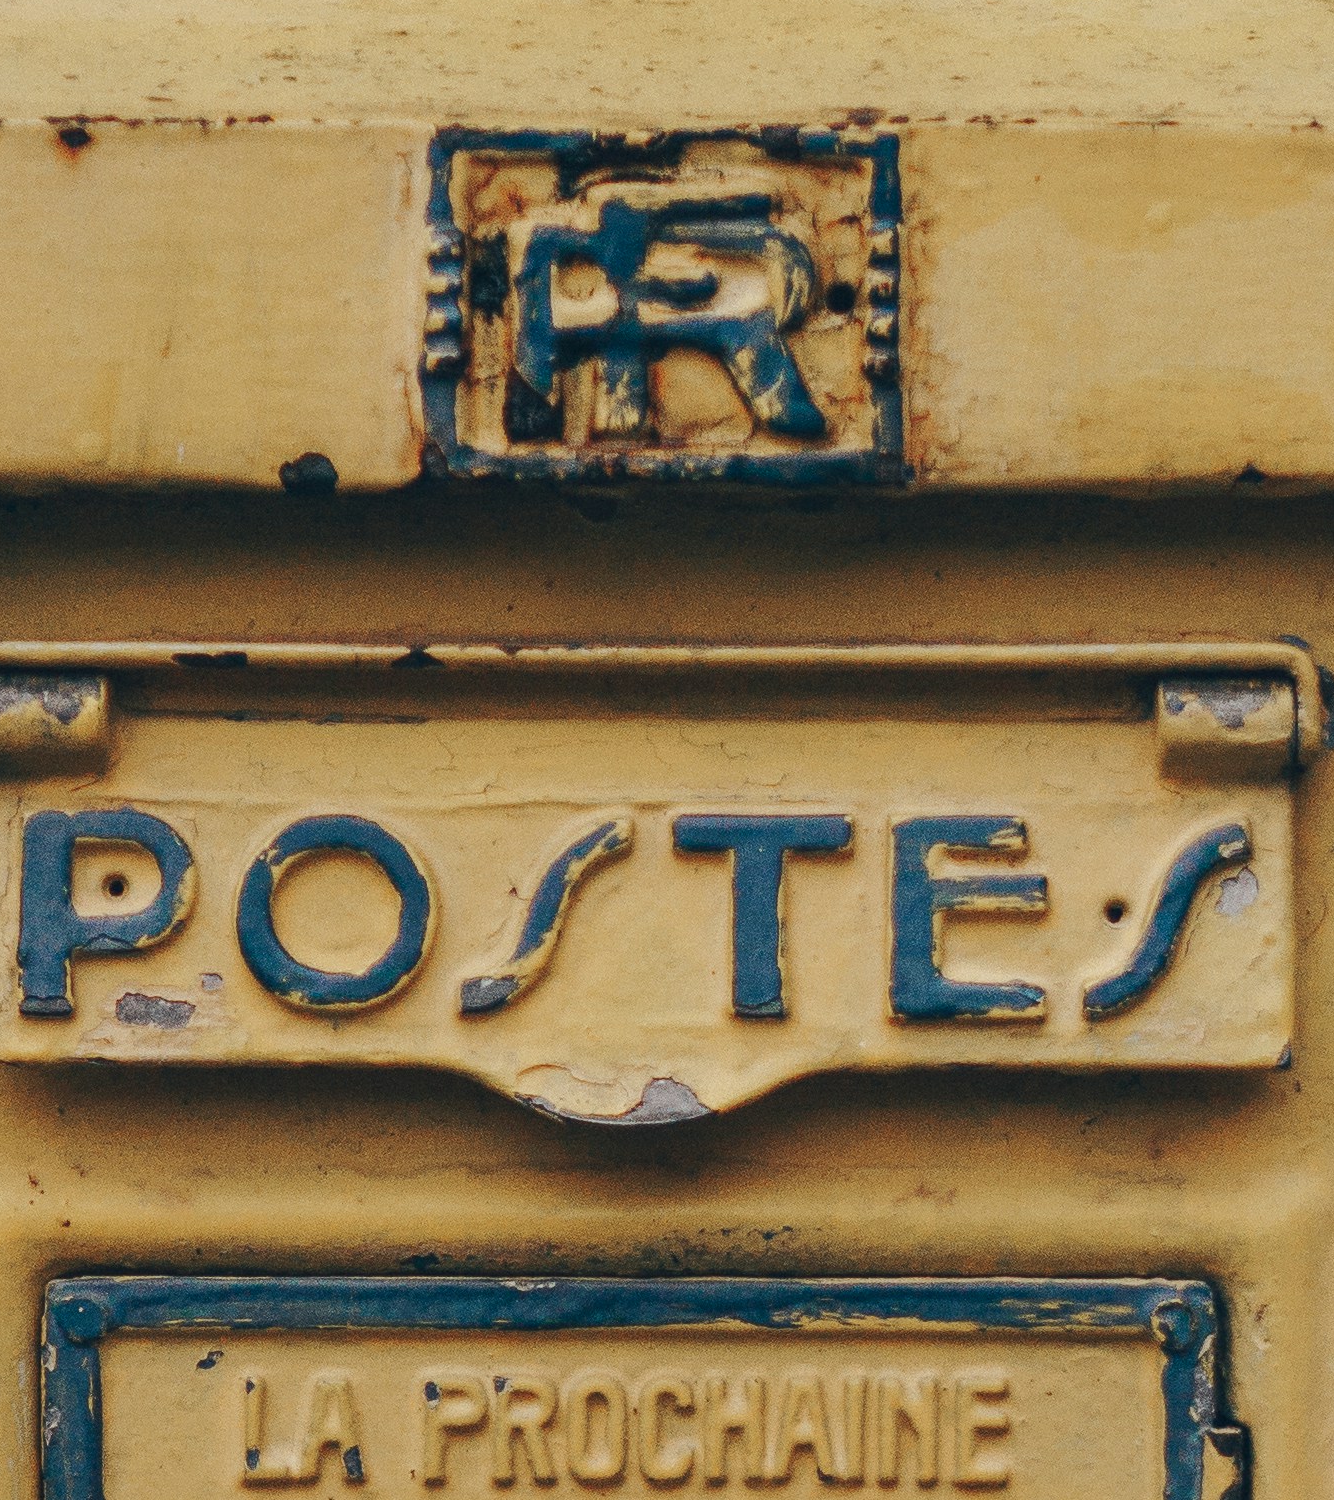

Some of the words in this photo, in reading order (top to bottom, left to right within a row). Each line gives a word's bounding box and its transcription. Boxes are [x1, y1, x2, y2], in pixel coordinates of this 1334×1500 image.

[14, 806, 1253, 1020] POSTES
[239, 1368, 367, 1488] LA
[418, 1366, 1012, 1490] PROCHAINE
